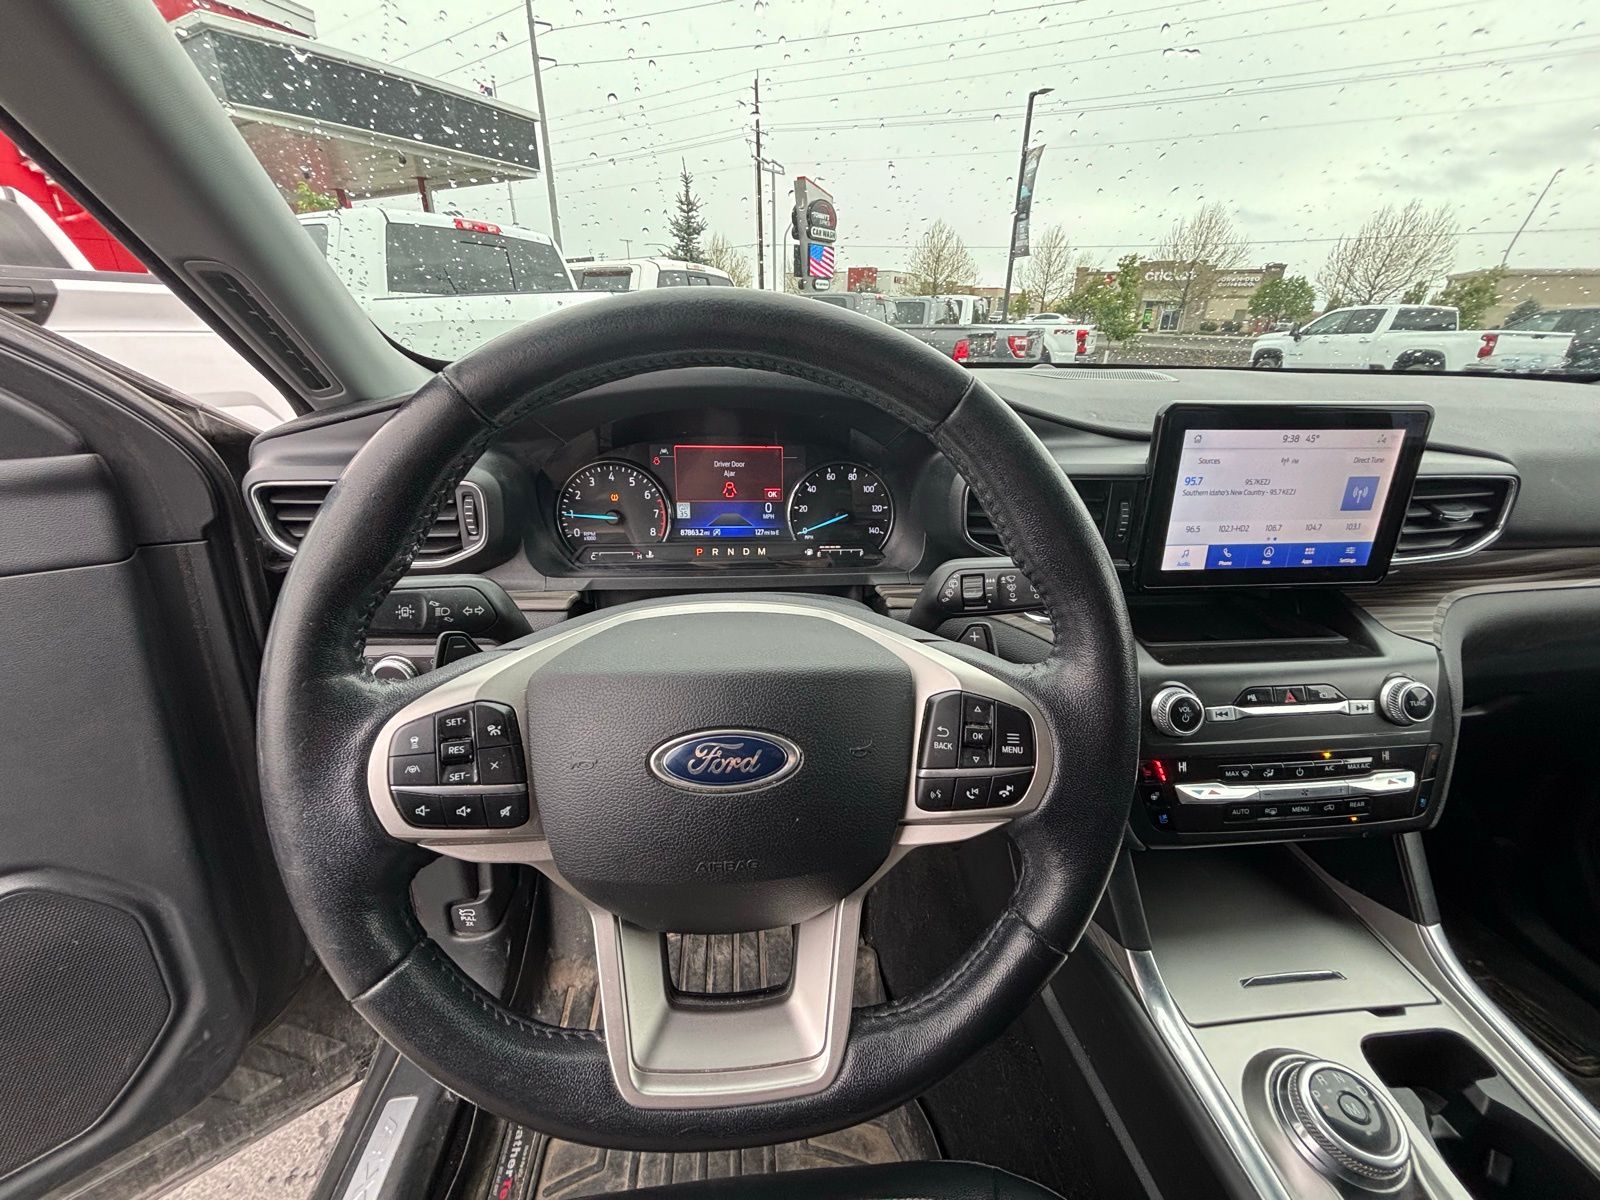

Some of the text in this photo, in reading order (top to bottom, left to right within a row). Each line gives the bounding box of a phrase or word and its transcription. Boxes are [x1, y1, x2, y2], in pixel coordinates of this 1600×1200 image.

[812, 228, 835, 238] CAR WASH
[1282, 435, 1320, 443] 9:38 45°
[609, 472, 614, 481] 4
[589, 477, 595, 486] 3
[630, 477, 635, 486] 5
[1184, 477, 1203, 486] 95.7
[575, 491, 581, 500] 2
[644, 491, 651, 499] 6
[765, 503, 772, 513] 0
[654, 509, 659, 518] 7
[574, 528, 580, 537] 0
[650, 528, 656, 536] 8
[696, 548, 703, 556] P
[712, 548, 718, 556] R
[728, 548, 734, 556] N
[743, 548, 750, 556] D
[446, 718, 467, 727] SET+
[448, 746, 465, 754] RES
[934, 742, 952, 750] BACK
[687, 742, 761, 774] Ford
[1382, 751, 1390, 761] HI
[1178, 762, 1187, 772] HI
[695, 860, 761, 872] AIRBAG
[1315, 1074, 1328, 1085] R
[1332, 1072, 1346, 1083] N
[1312, 1090, 1321, 1101] P
[1357, 1086, 1368, 1096] D
[1344, 1102, 1361, 1116] M
